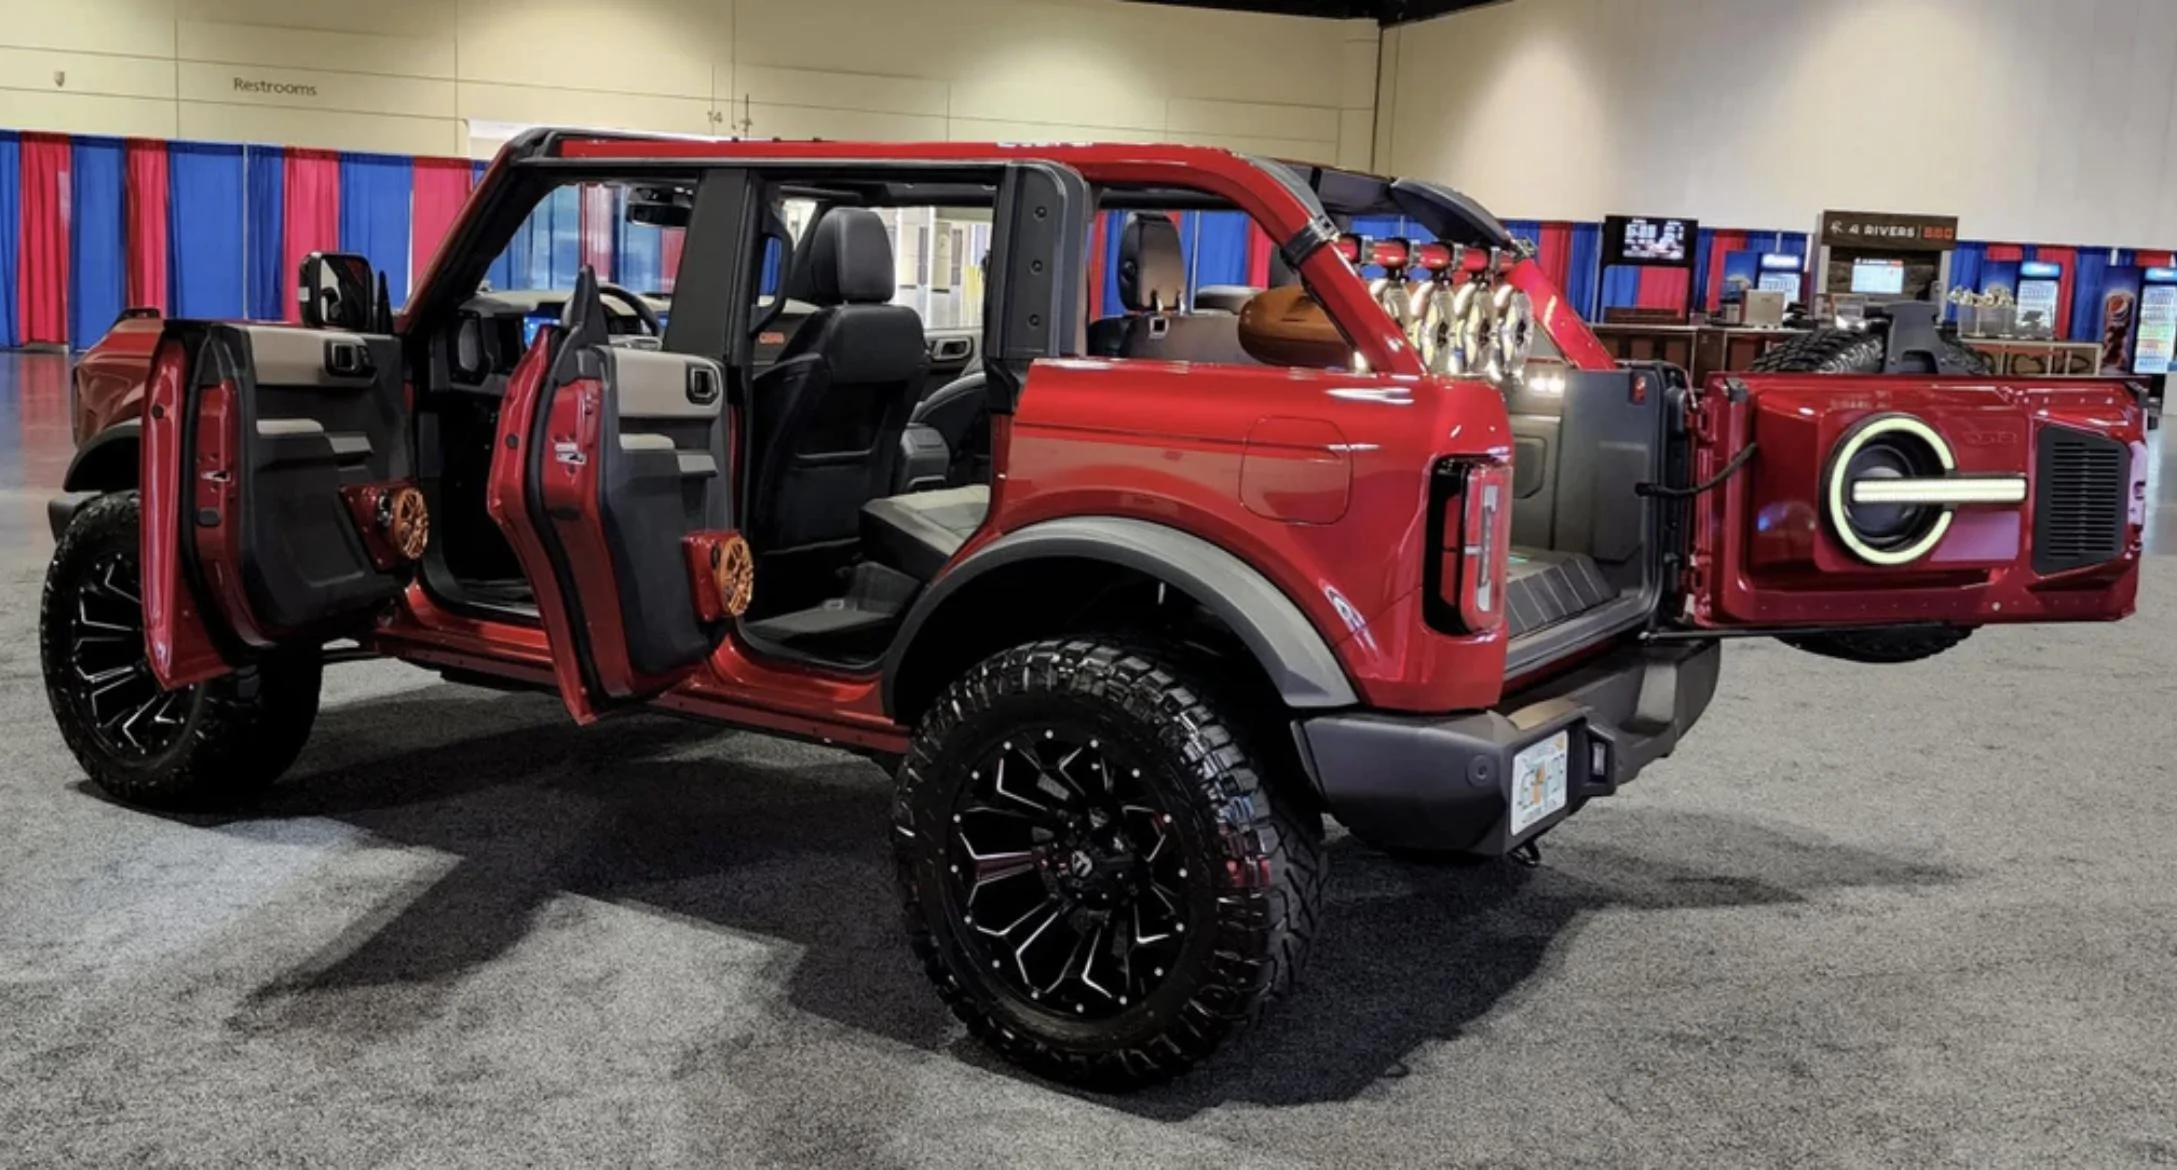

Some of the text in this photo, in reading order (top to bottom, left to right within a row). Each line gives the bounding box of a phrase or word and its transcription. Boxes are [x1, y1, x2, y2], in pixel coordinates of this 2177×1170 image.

[234, 77, 318, 96] Restrooms
[1848, 223, 1859, 235] 4
[1863, 224, 1915, 238] RIVERS
